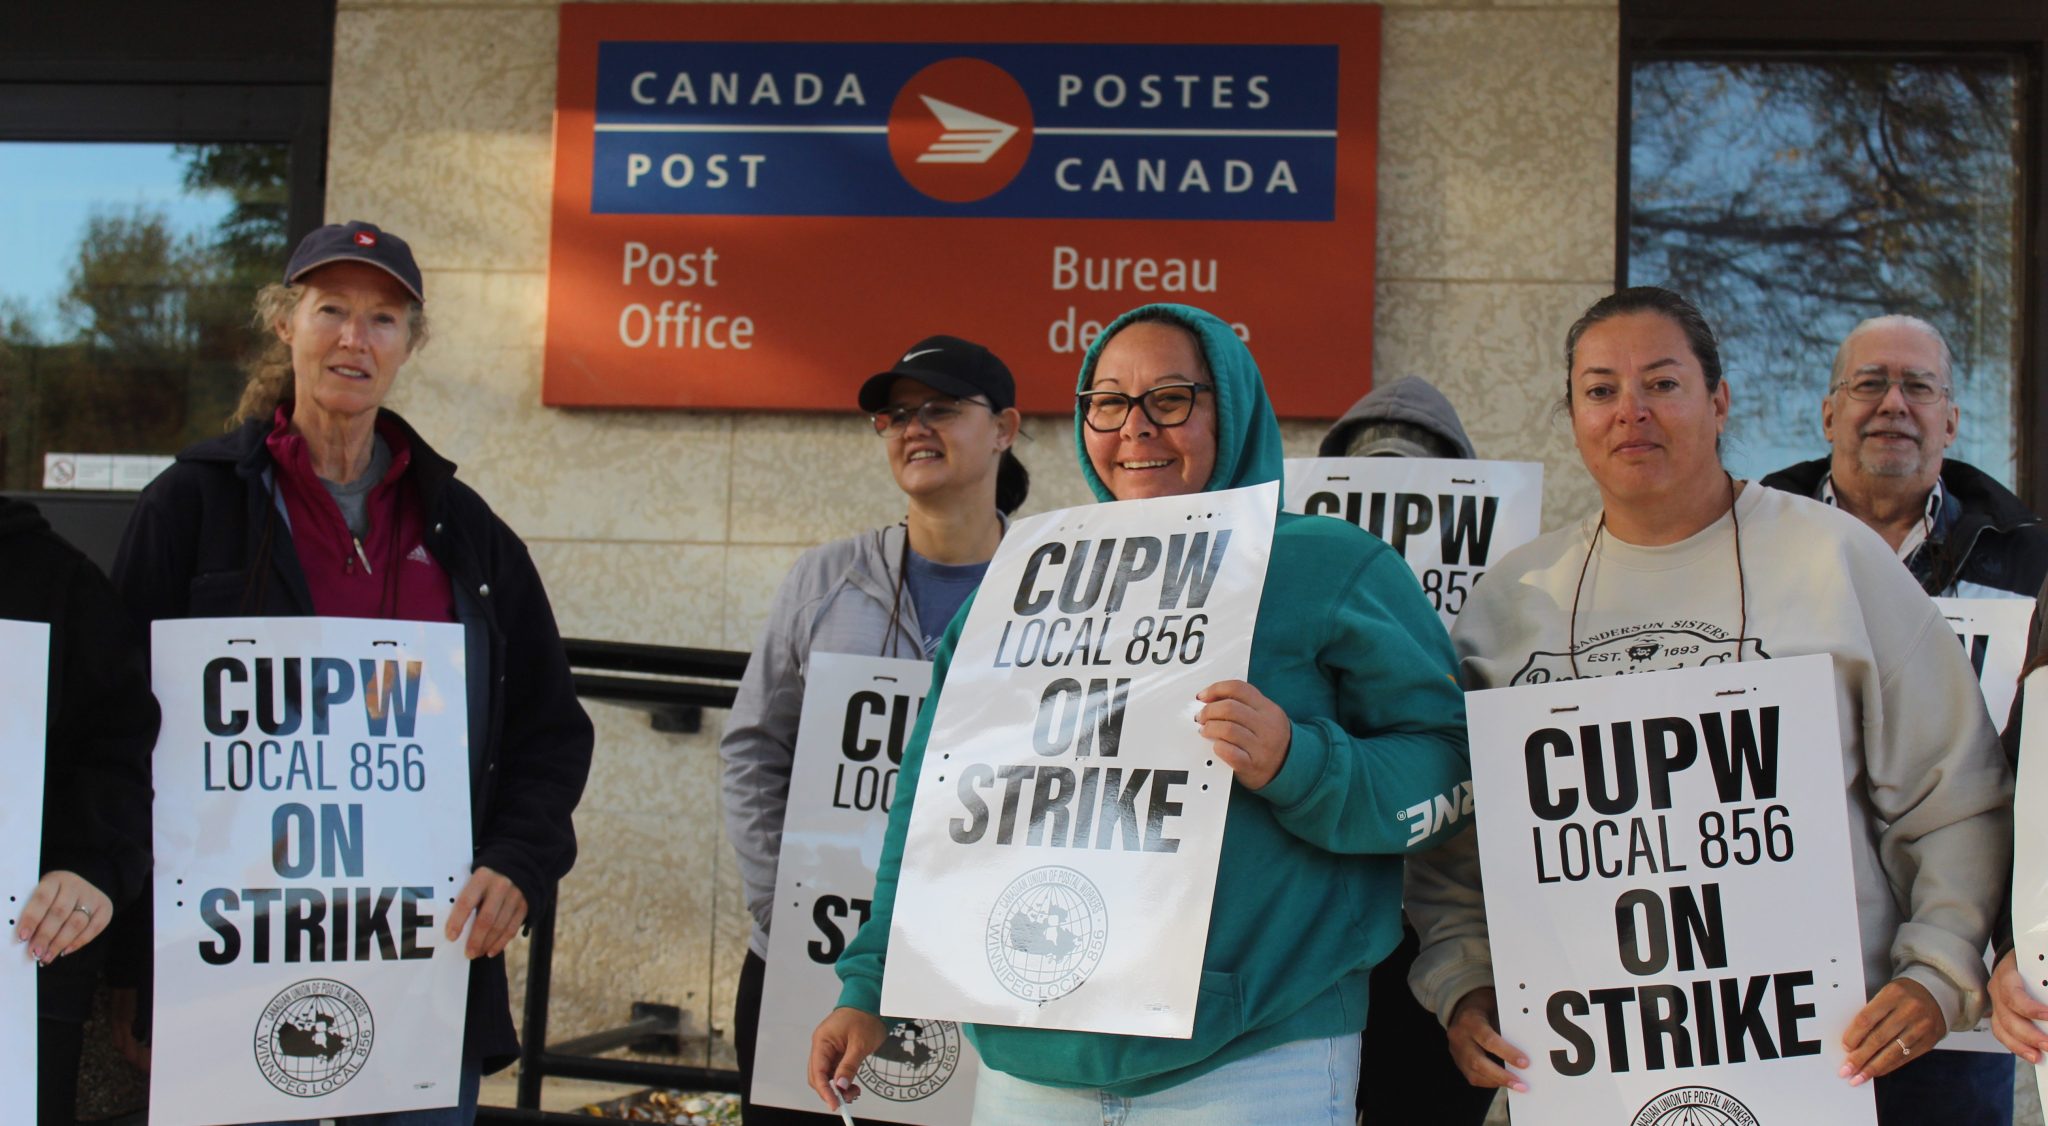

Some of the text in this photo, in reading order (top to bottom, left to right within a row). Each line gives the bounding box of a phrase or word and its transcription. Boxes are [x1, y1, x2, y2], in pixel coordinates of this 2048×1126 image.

[630, 72, 866, 106] CANADA
[1058, 74, 1271, 109] POSTES
[626, 153, 766, 188] POST
[1054, 158, 1298, 194] CANADA
[622, 242, 719, 286] Post
[1052, 246, 1218, 292] Bureau
[618, 300, 754, 349] Office
[1013, 528, 1232, 616] CUPW
[1422, 569, 1486, 615] 85
[993, 614, 1112, 668] LOCAL
[1125, 613, 1209, 665] 856
[1569, 620, 1729, 651] SANDERSON SISTERS
[1587, 645, 1700, 662] EST. 1693
[203, 656, 423, 738] CUPW
[1032, 677, 1131, 758] ON
[204, 740, 426, 792] LOCAL 856
[1524, 706, 1780, 821] CUPW
[949, 763, 1189, 854] STRIKE
[272, 802, 364, 879] ON
[1532, 804, 1794, 884] LOCAL 856
[1000, 870, 1104, 914] CANADIAN UNION OF POSTAL WORKERS
[198, 886, 435, 966] STRIKE
[1614, 883, 1728, 976] ON
[988, 924, 1104, 998] WINNIPEG LOCAL 856
[1546, 970, 1822, 1076] STRIKE
[257, 1030, 372, 1094] WINNIPEG LOCAL 856
[900, 1075, 947, 1098] LOCAL
[942, 1045, 957, 1072] 856
[1658, 1092, 1682, 1112] UNION
[1682, 1090, 1692, 1103] OF
[1694, 1090, 1720, 1108] POSTAL
[1722, 1098, 1754, 1126] WORKERS
